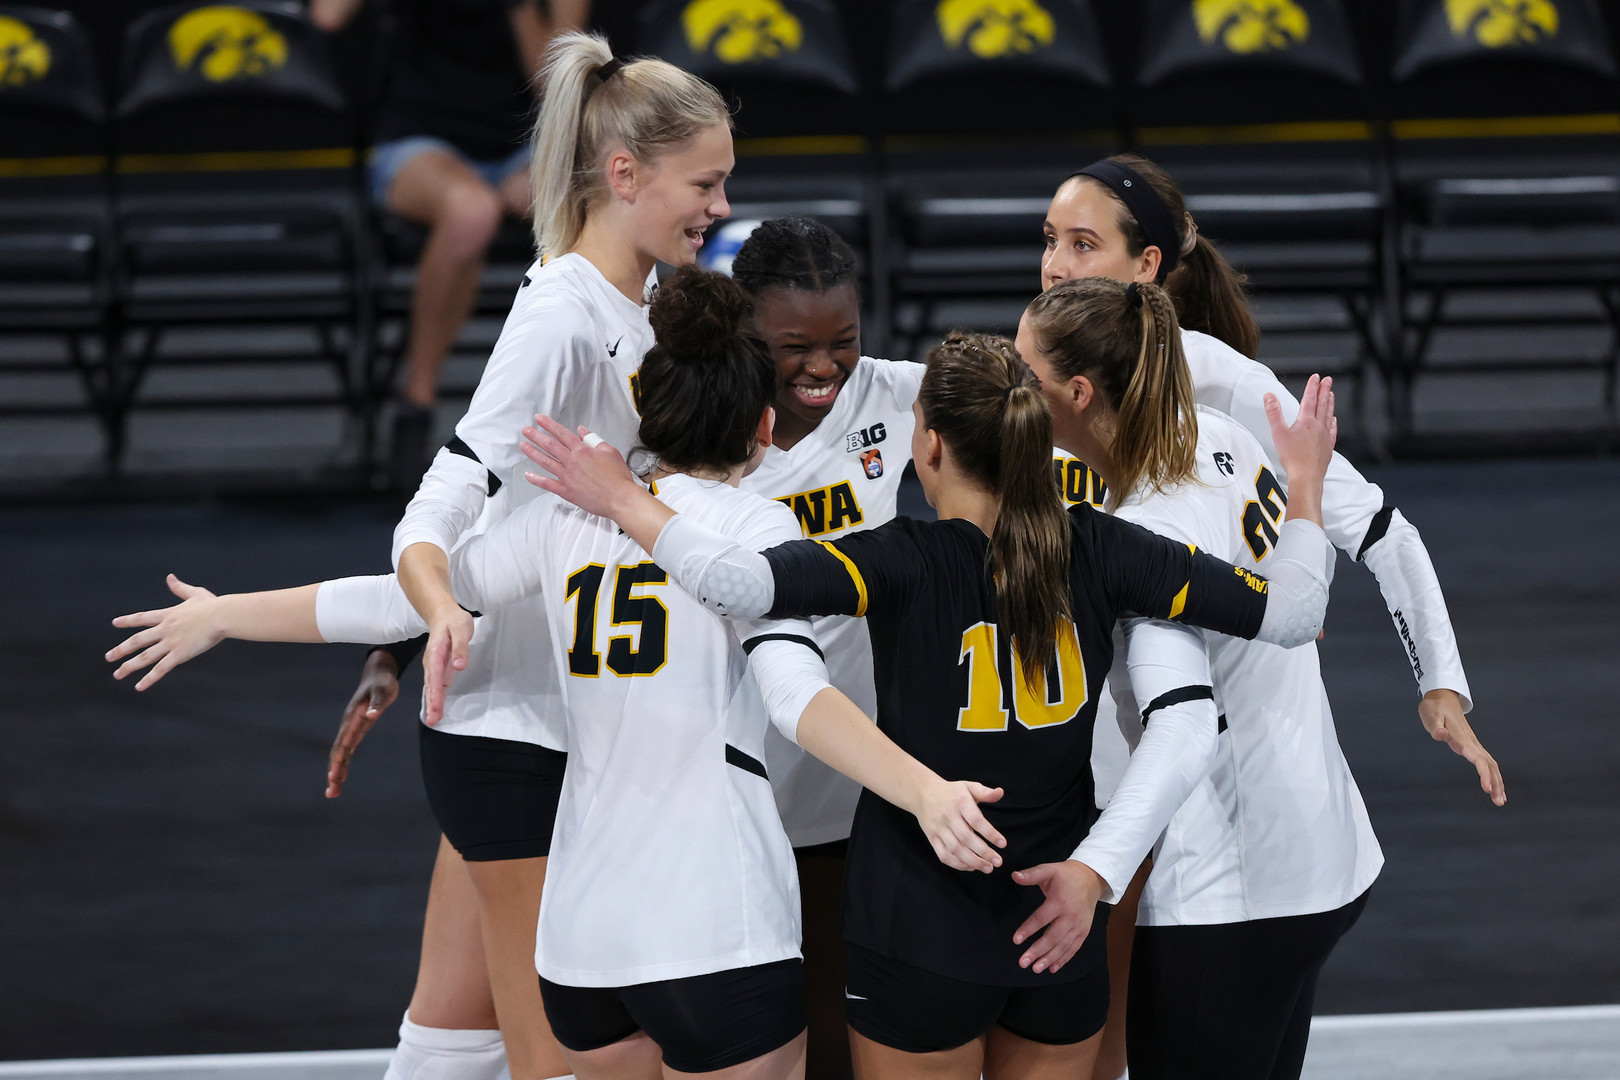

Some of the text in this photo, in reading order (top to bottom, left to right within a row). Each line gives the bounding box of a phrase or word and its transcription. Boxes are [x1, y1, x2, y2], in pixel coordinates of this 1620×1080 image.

[771, 479, 865, 539] WA
[564, 560, 669, 678] 15
[956, 611, 1089, 732] 10
